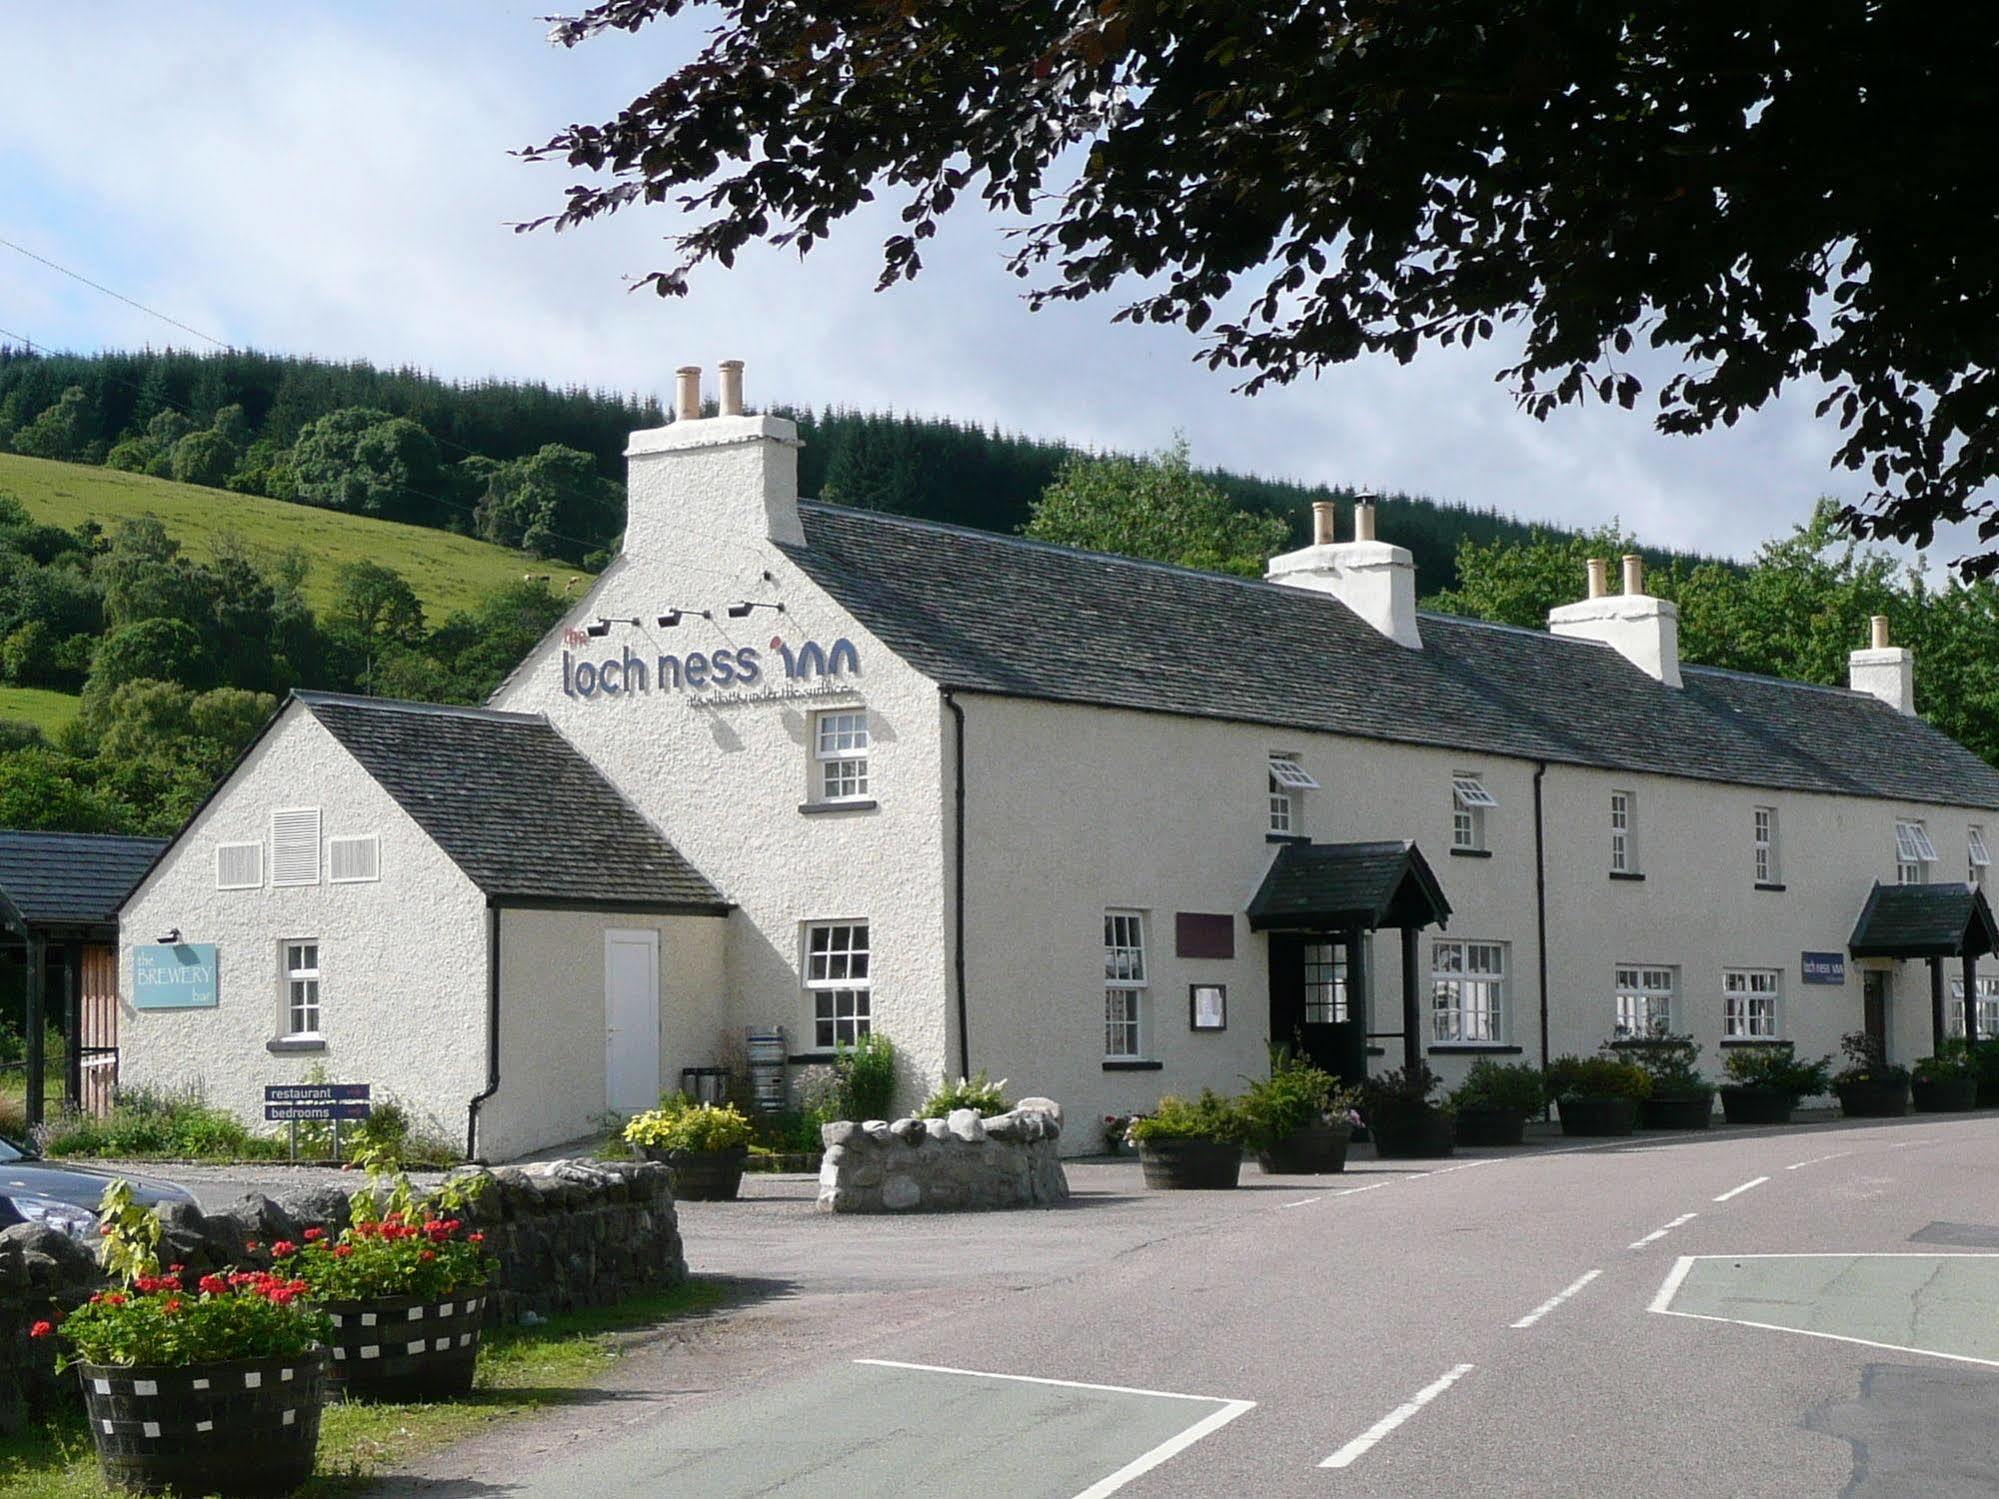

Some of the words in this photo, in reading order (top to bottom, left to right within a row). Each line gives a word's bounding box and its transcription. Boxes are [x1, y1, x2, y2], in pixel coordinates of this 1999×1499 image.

[564, 626, 588, 645] the
[562, 646, 645, 696] loch
[658, 647, 758, 687] ness
[769, 635, 858, 678] inn
[745, 684, 778, 701] under
[138, 952, 153, 966] the
[138, 966, 212, 985] BREWERY
[192, 985, 209, 1001] bar
[271, 1088, 332, 1099] restaurant
[271, 1107, 330, 1118] bedrooms
